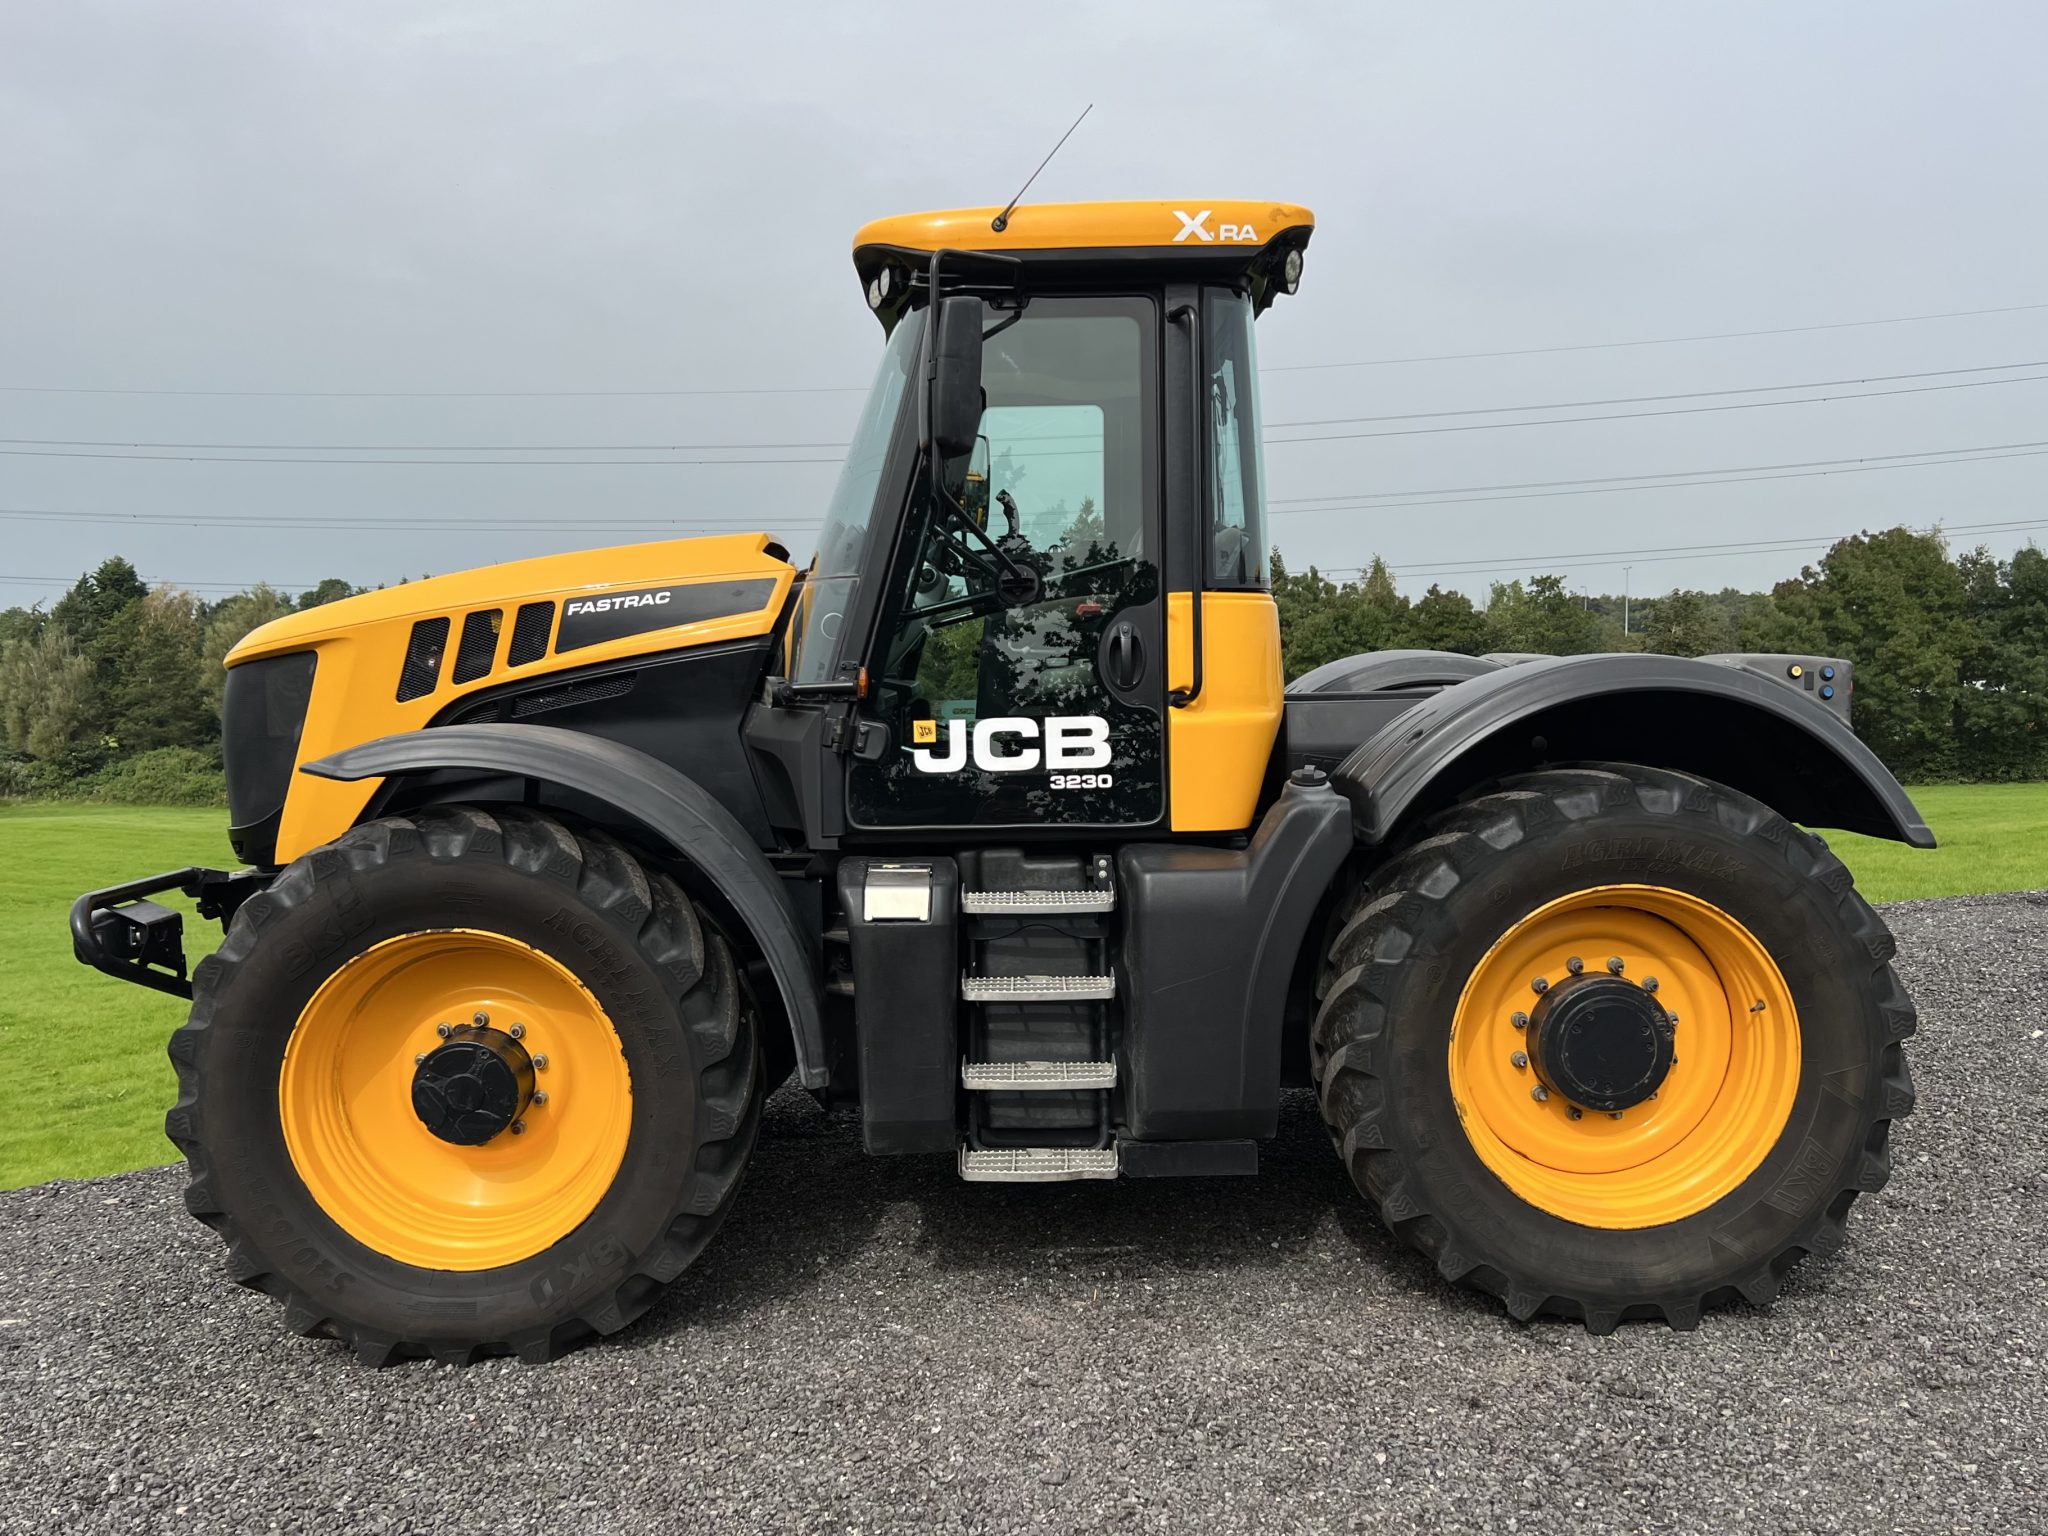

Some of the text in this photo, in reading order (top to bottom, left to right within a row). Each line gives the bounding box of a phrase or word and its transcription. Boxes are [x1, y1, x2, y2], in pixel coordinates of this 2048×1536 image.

[567, 591, 671, 616] FASTRAC
[914, 716, 1112, 773] JCB
[1050, 774, 1113, 789] 3230
[1772, 1142, 1834, 1213] BKT
